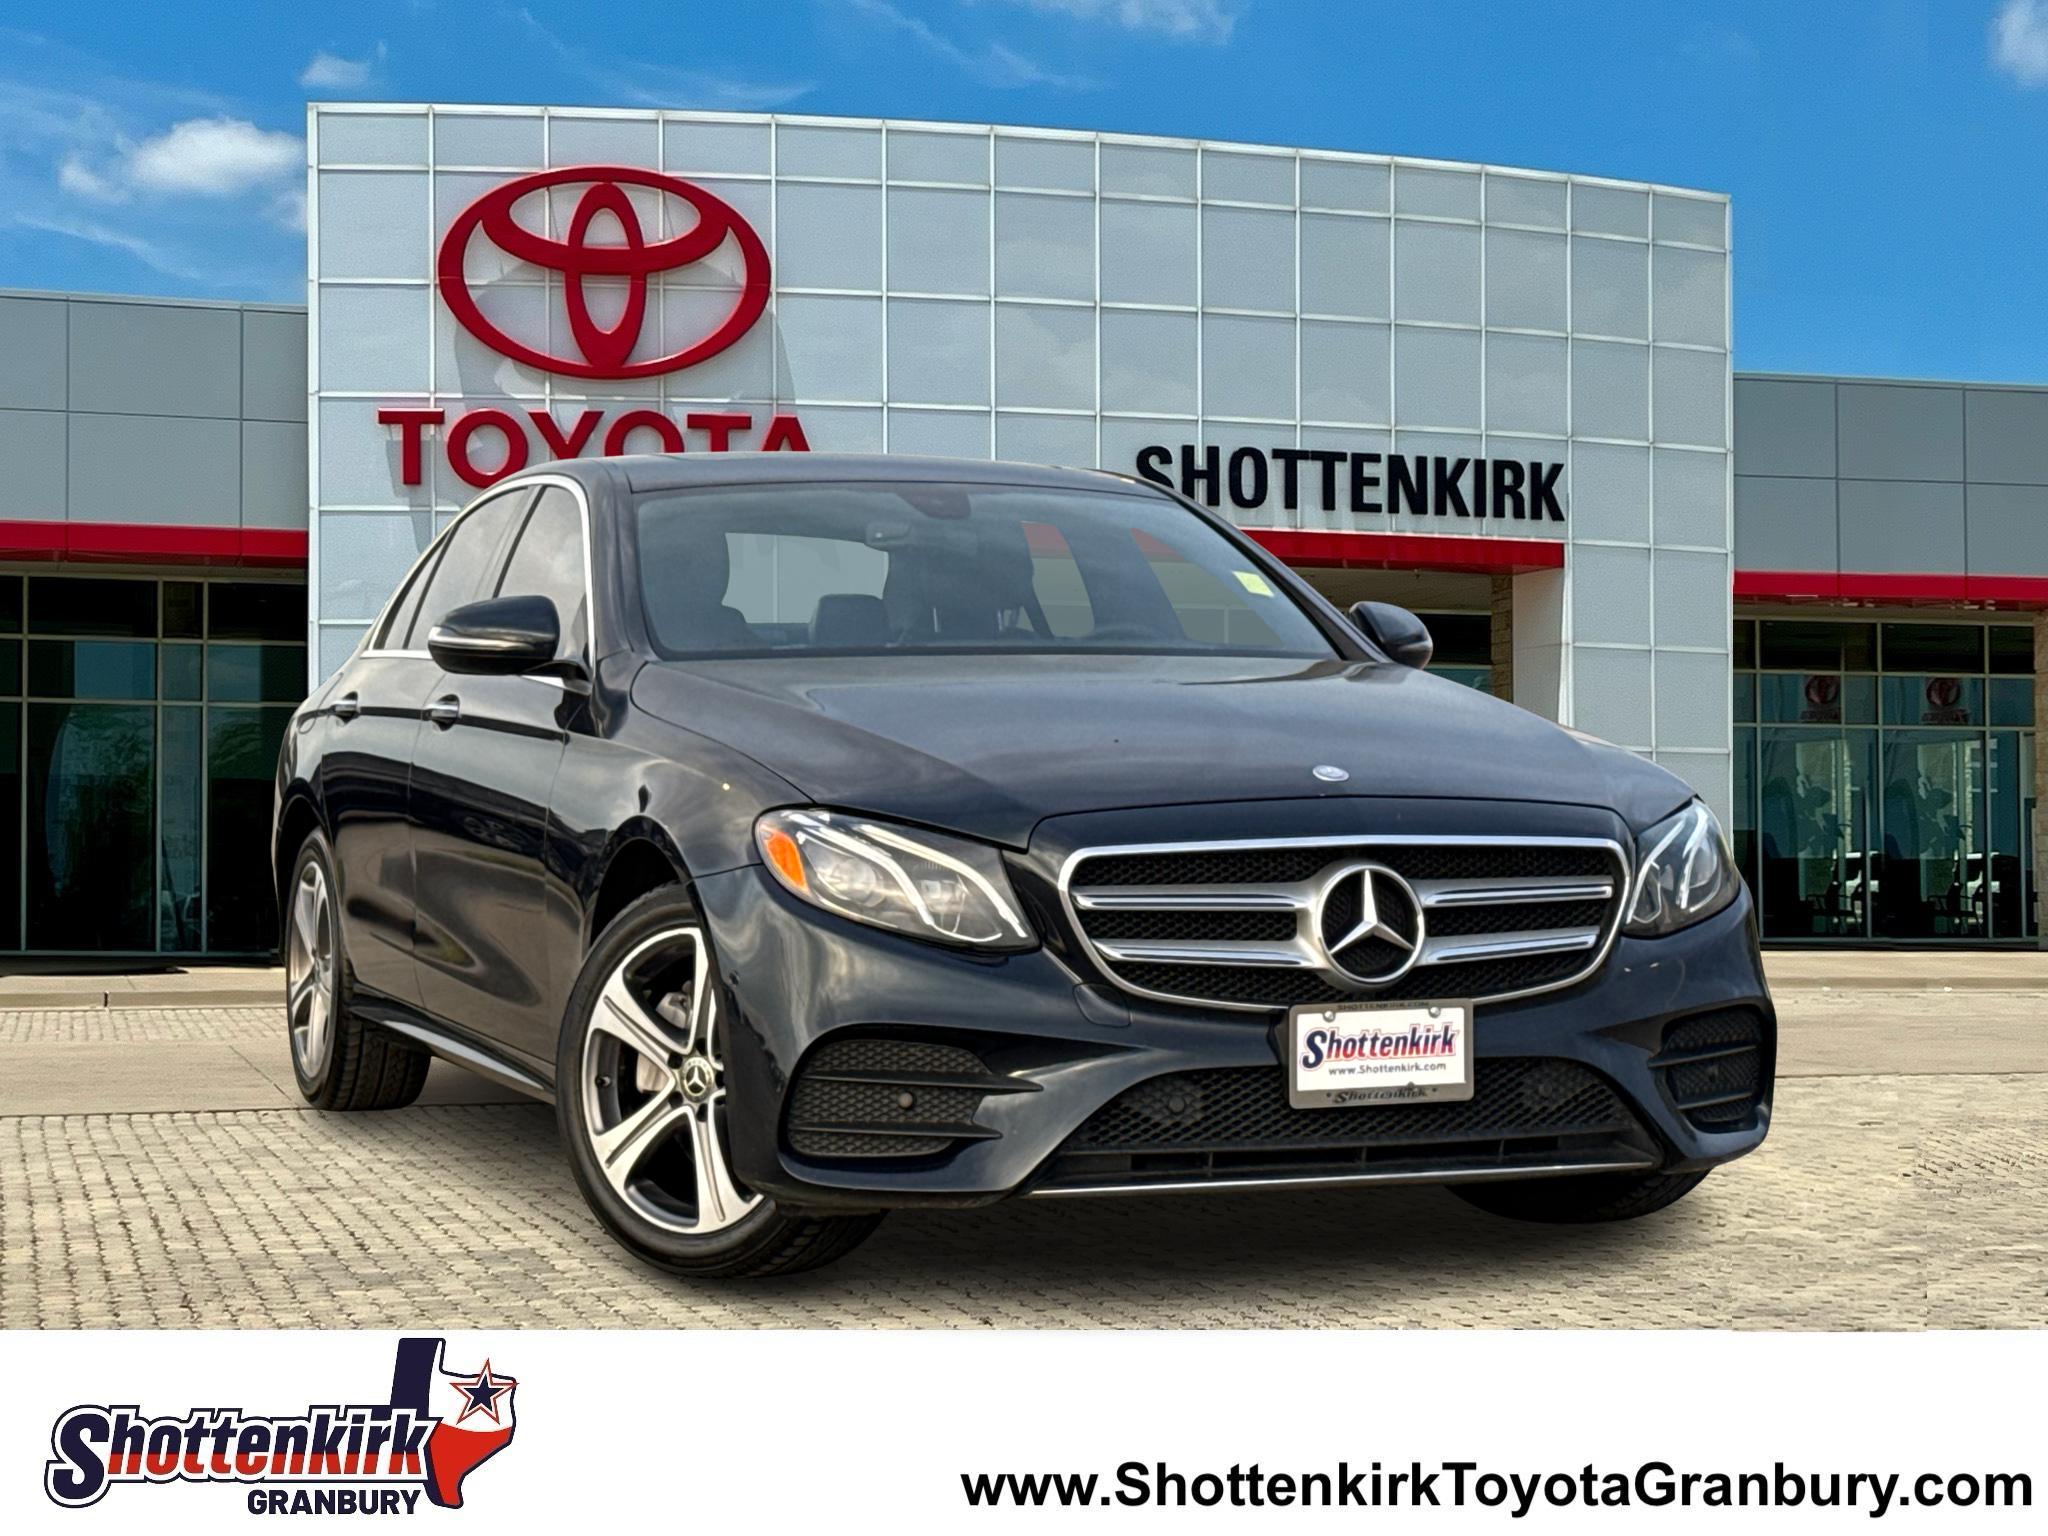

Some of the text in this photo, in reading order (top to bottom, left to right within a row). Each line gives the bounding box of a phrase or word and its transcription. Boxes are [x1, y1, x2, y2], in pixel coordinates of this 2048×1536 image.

[1136, 445, 1565, 521] SHOTTENKIRK
[1302, 1023, 1458, 1069] Shottenkirk
[1328, 1062, 1447, 1076] www.Shottenkirk.com
